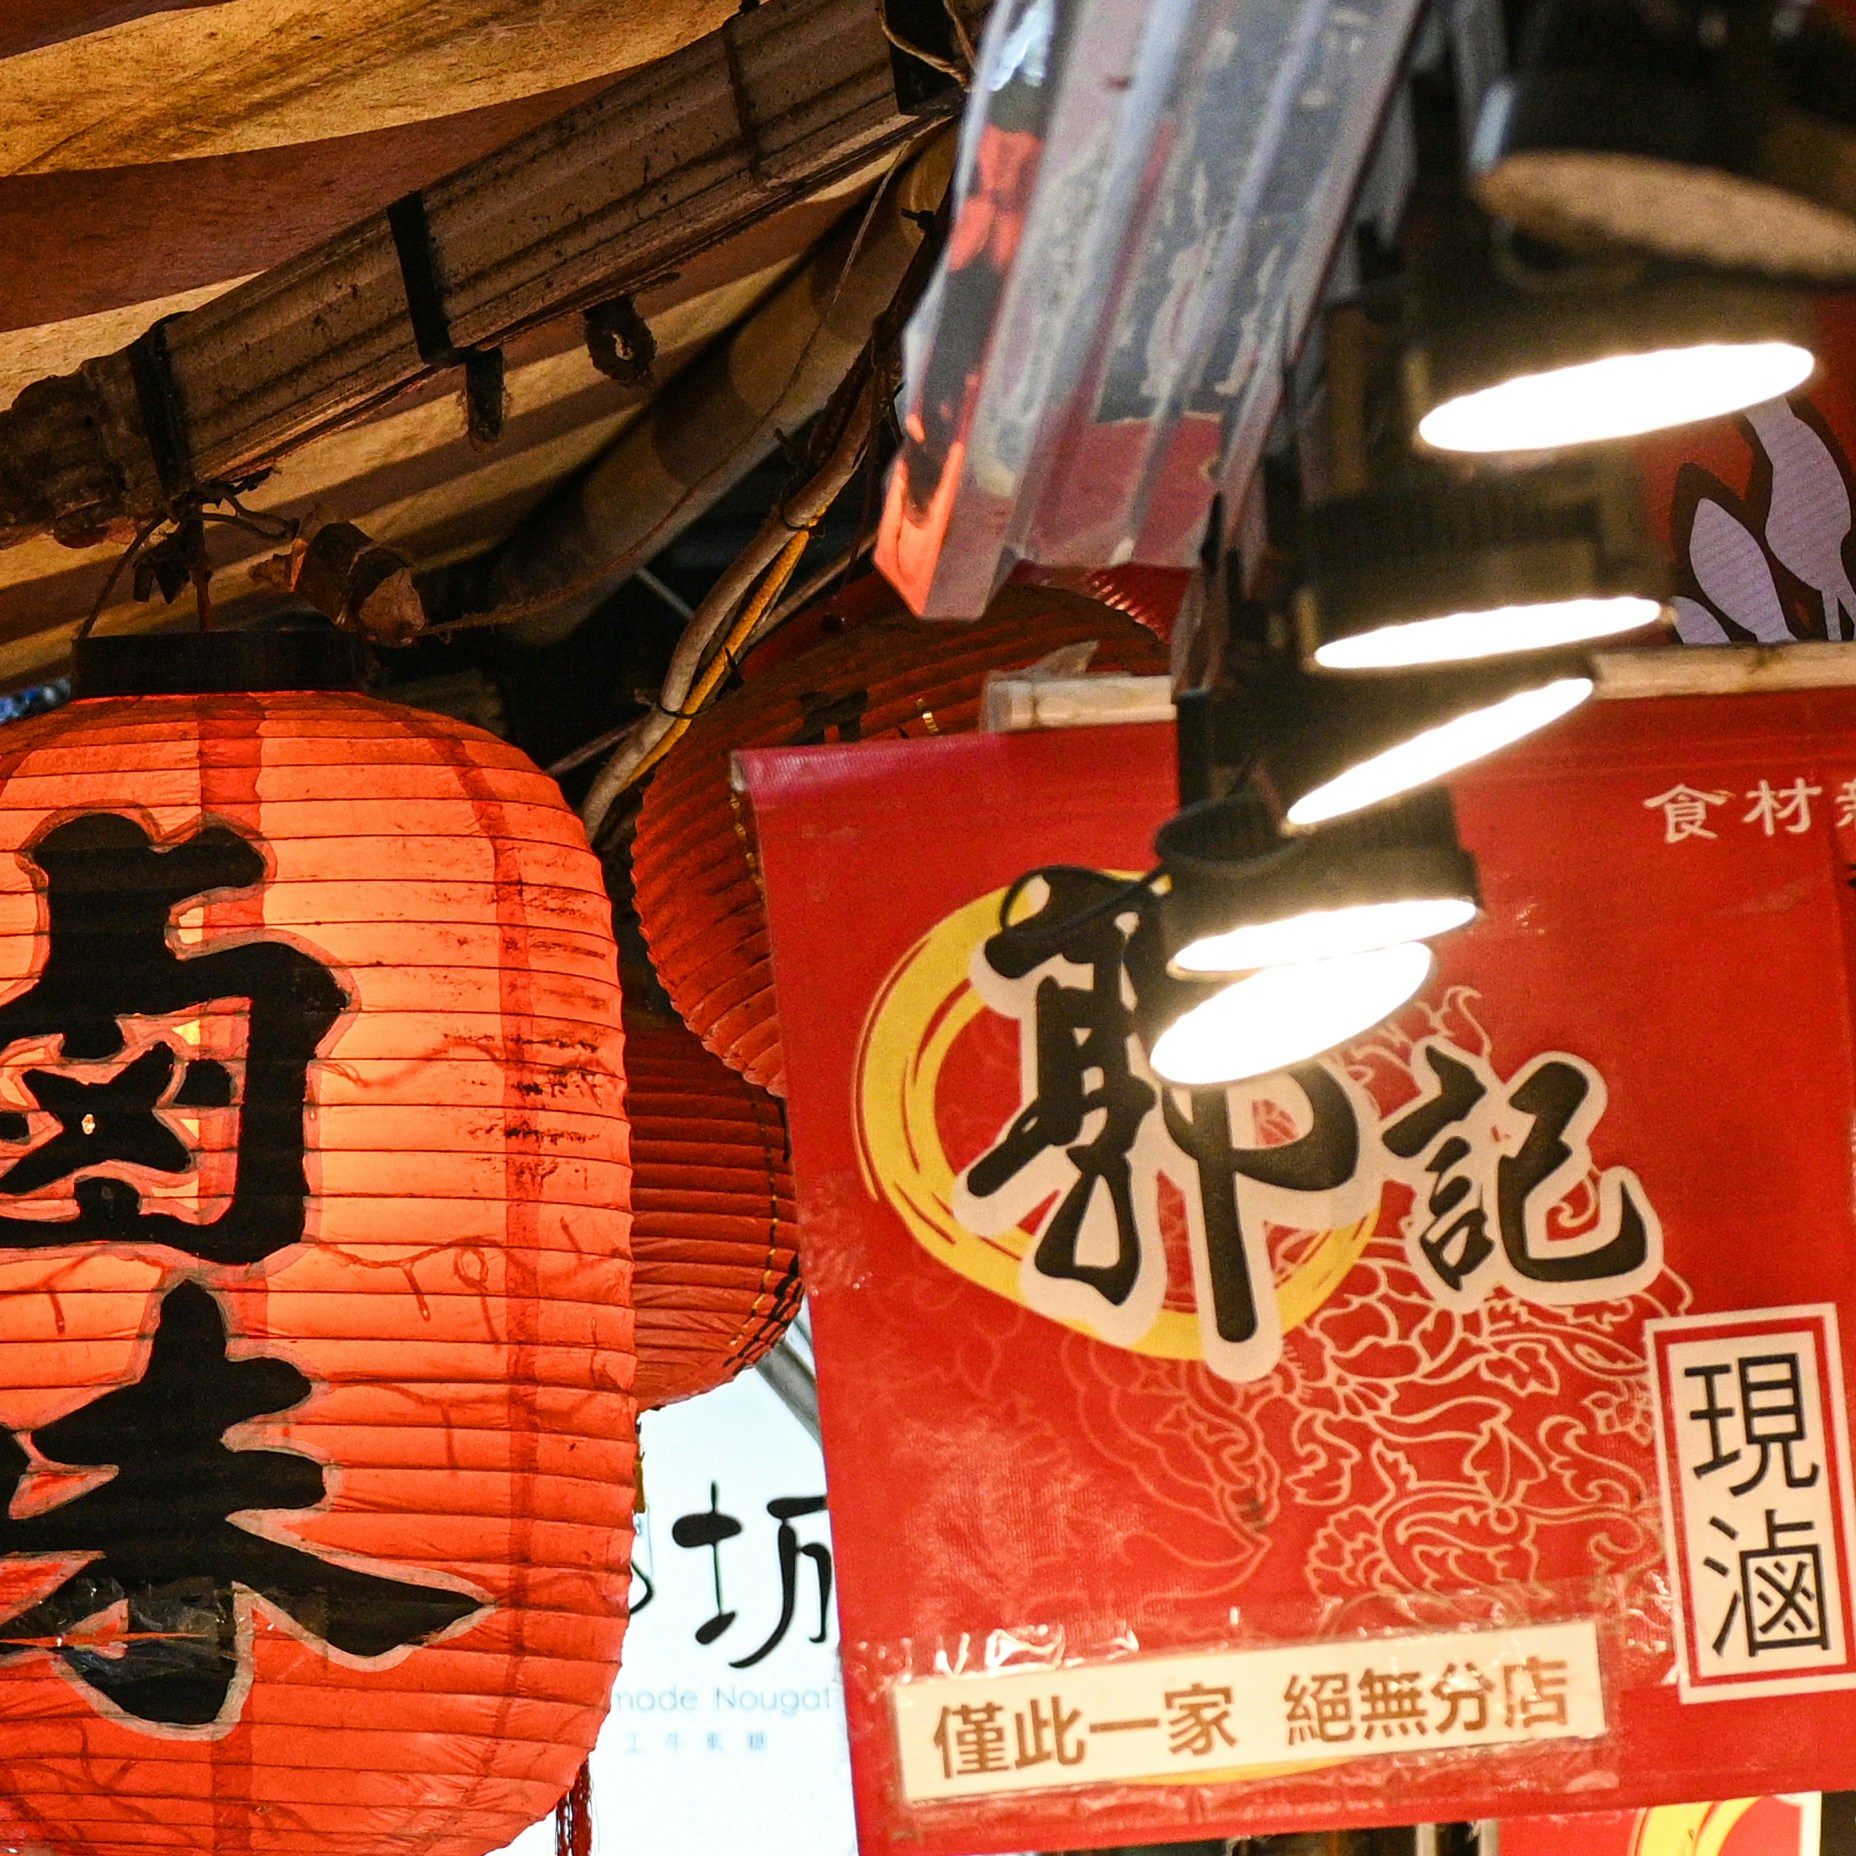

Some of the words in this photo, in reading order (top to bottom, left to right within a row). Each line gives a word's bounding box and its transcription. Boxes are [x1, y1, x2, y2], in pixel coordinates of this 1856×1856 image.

[1687, 1352, 1830, 1660] 現滷
[715, 1685, 831, 1719] Nougat
[932, 1682, 1240, 1779] 僅此一家
[1284, 1659, 1570, 1747] 絕無分店
